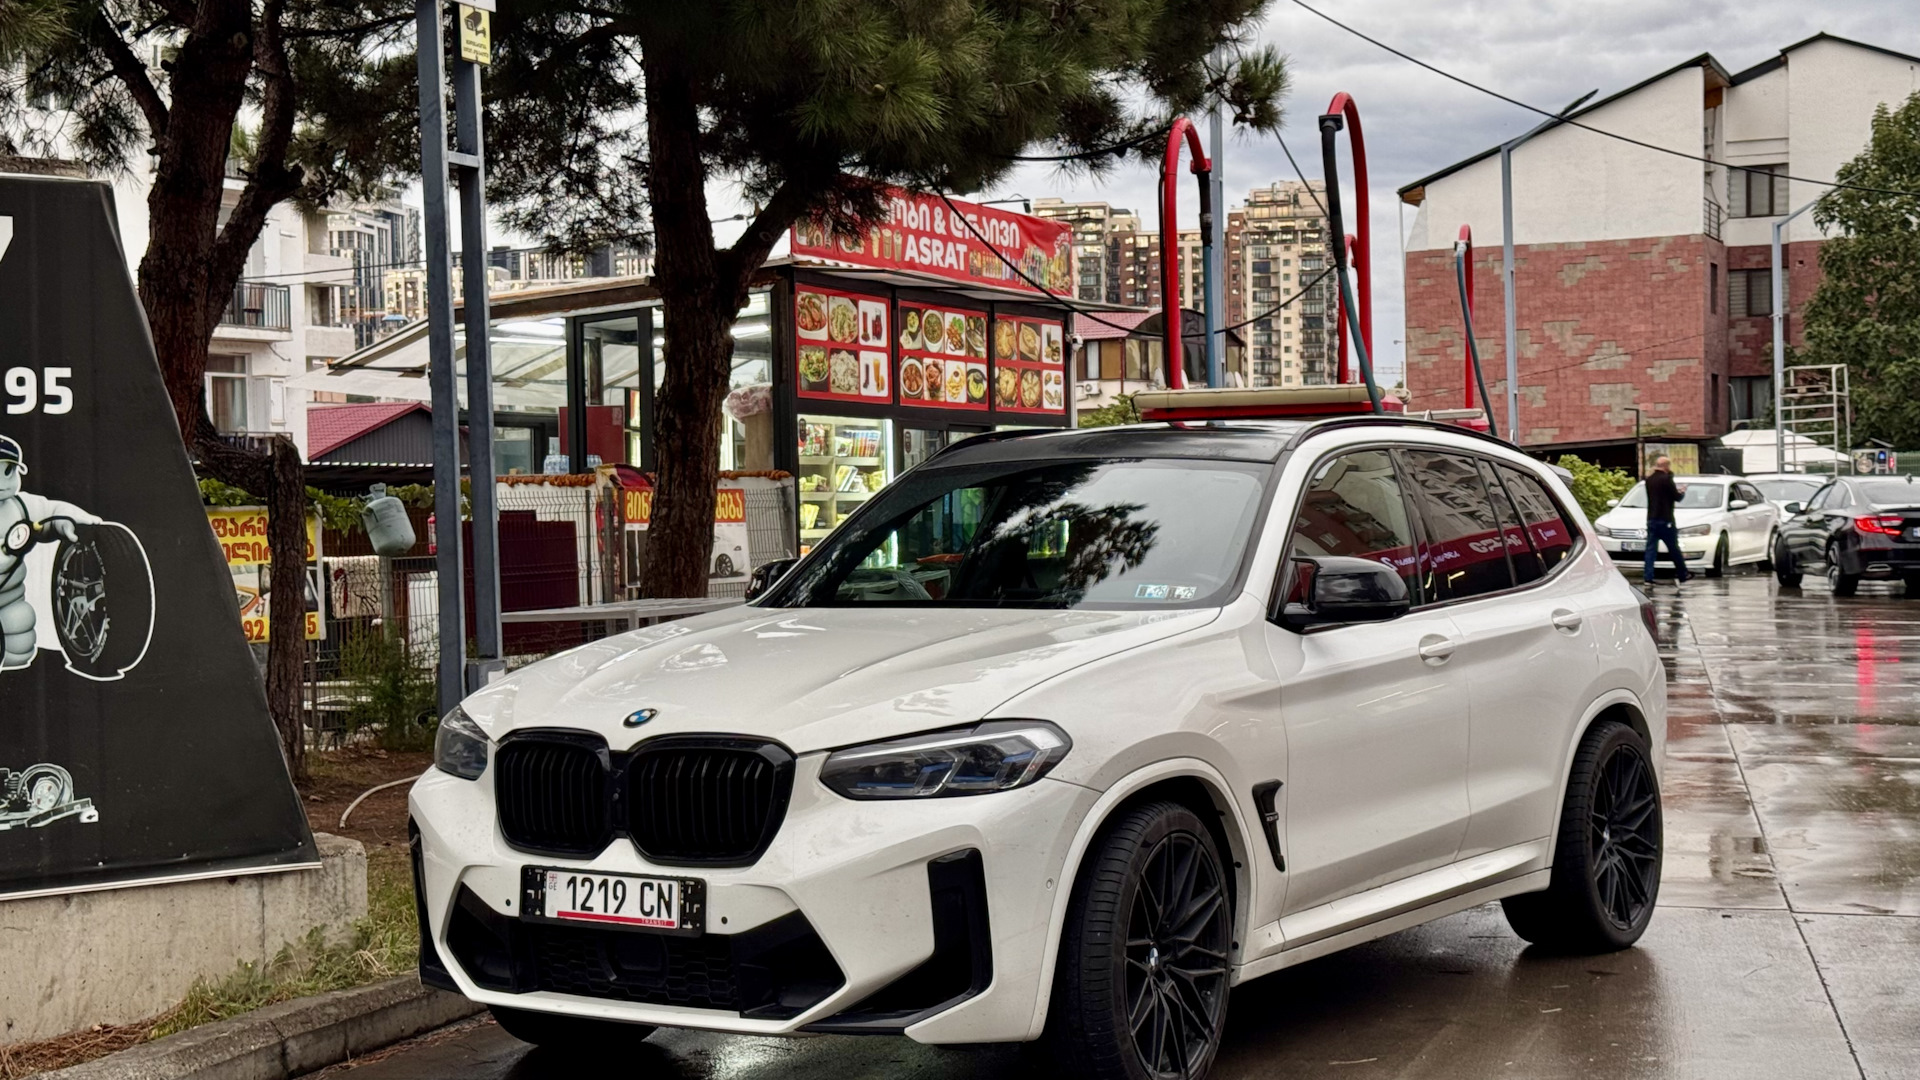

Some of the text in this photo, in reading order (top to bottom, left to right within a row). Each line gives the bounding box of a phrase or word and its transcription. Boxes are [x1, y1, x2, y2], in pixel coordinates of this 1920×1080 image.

[933, 206, 947, 235] &
[904, 234, 968, 271] ASRAT
[5, 366, 74, 414] 95
[548, 882, 558, 891] GE
[566, 876, 673, 919] 1219 CN
[641, 918, 667, 926] TRANSIT
